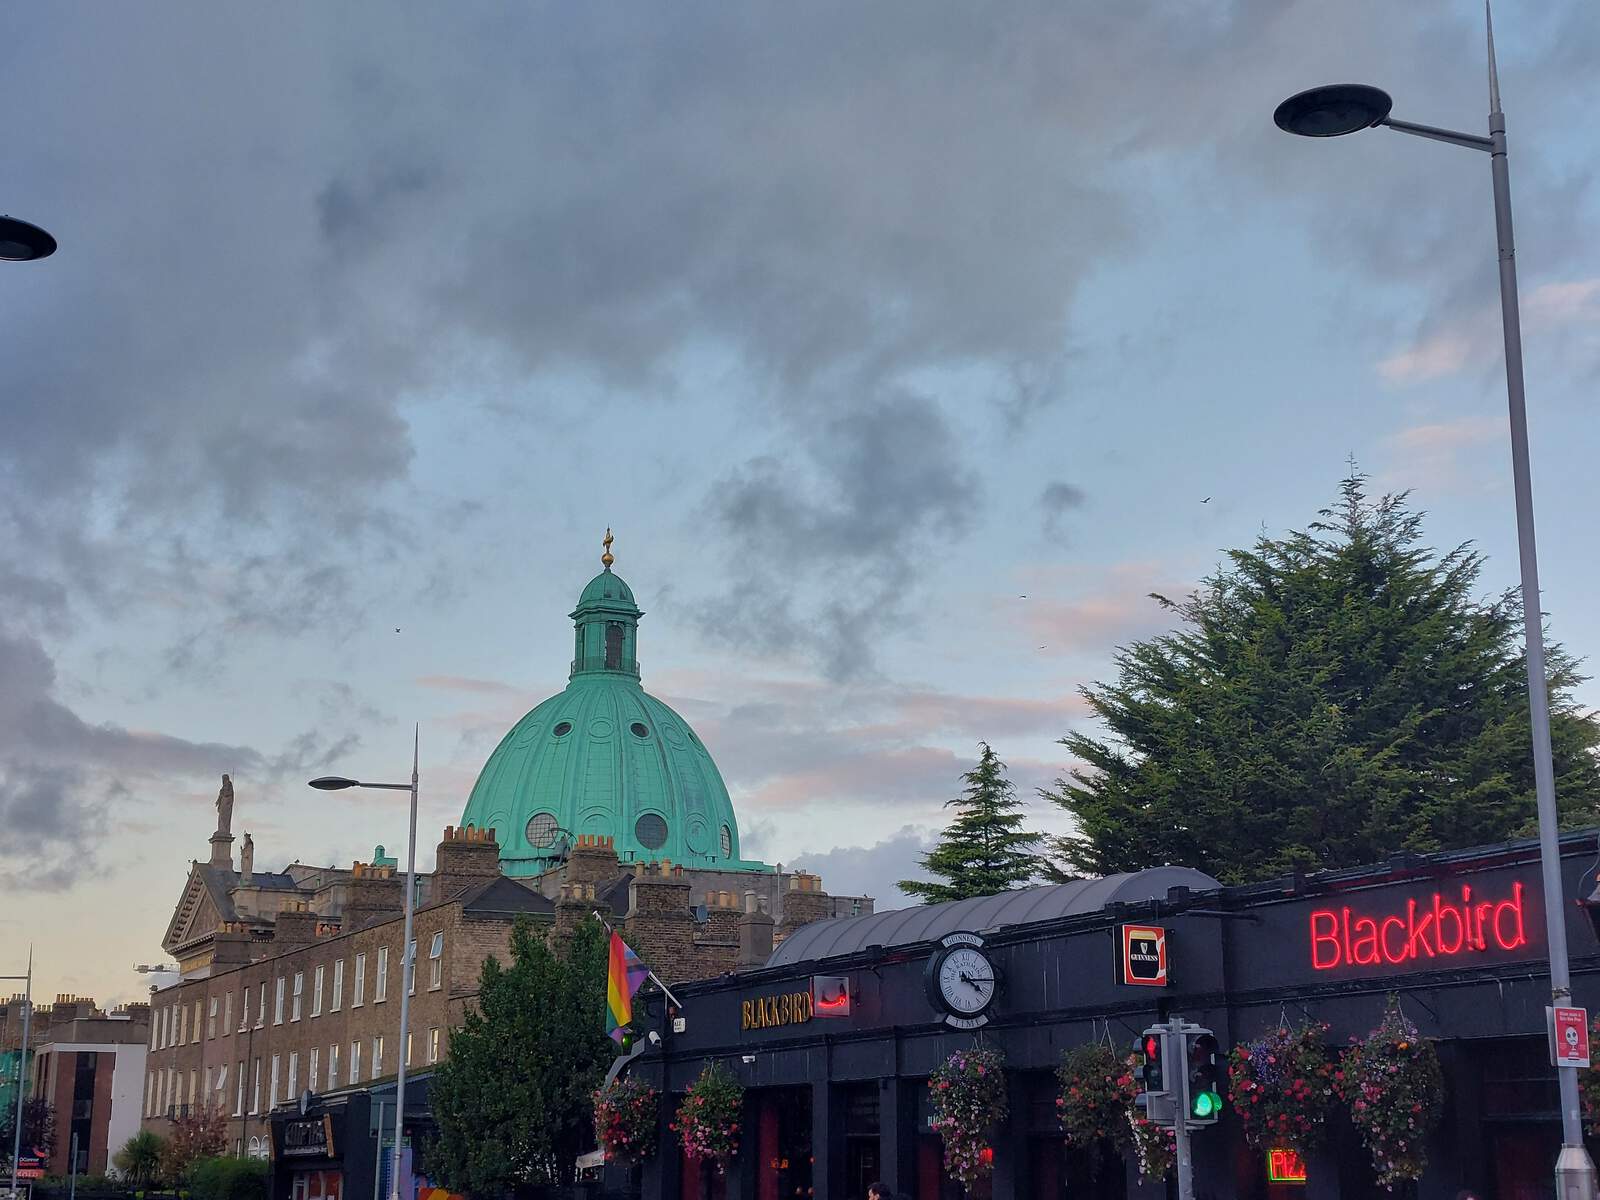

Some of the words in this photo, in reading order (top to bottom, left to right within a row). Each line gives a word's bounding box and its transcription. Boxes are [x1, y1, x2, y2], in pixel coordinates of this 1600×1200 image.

[1310, 880, 1526, 970] Blackbird
[946, 935, 977, 945] GUINNESS
[1130, 953, 1159, 961] GUINNESS
[742, 991, 812, 1030] BLACKBIRD
[954, 1019, 981, 1028] TIME
